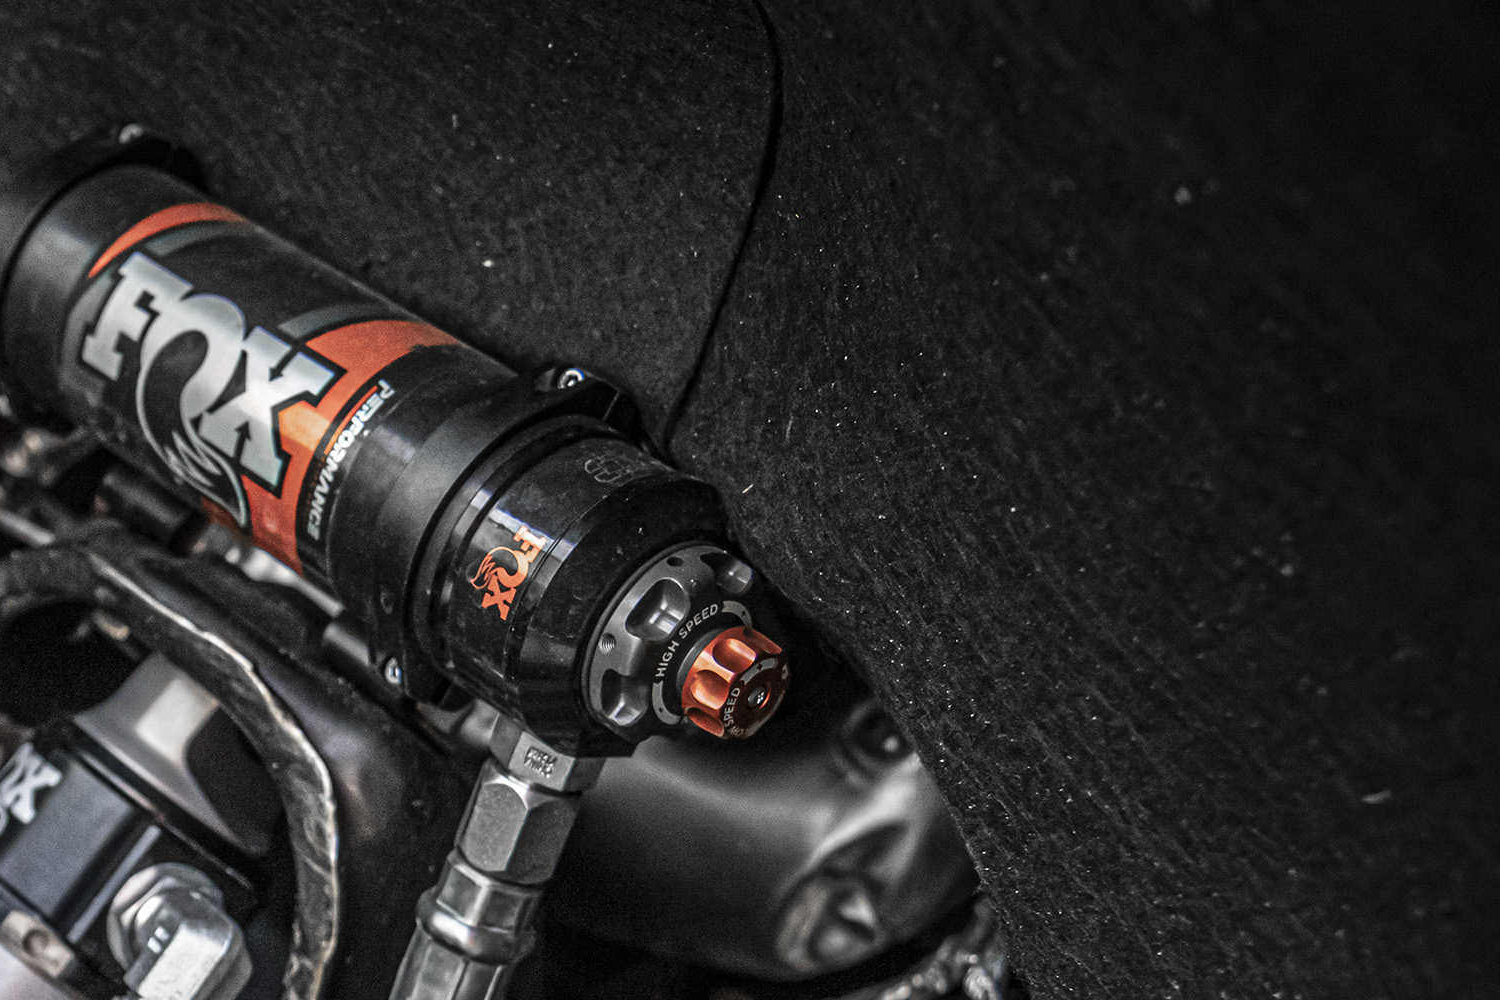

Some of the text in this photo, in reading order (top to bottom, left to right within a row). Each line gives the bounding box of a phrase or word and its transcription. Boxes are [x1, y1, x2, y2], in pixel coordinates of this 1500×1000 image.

[82, 252, 335, 527] FOX
[307, 379, 396, 541] PERFORMANCE
[470, 525, 547, 621] FOX
[655, 604, 718, 677] HIGH SPEED
[723, 687, 741, 727] SPEED
